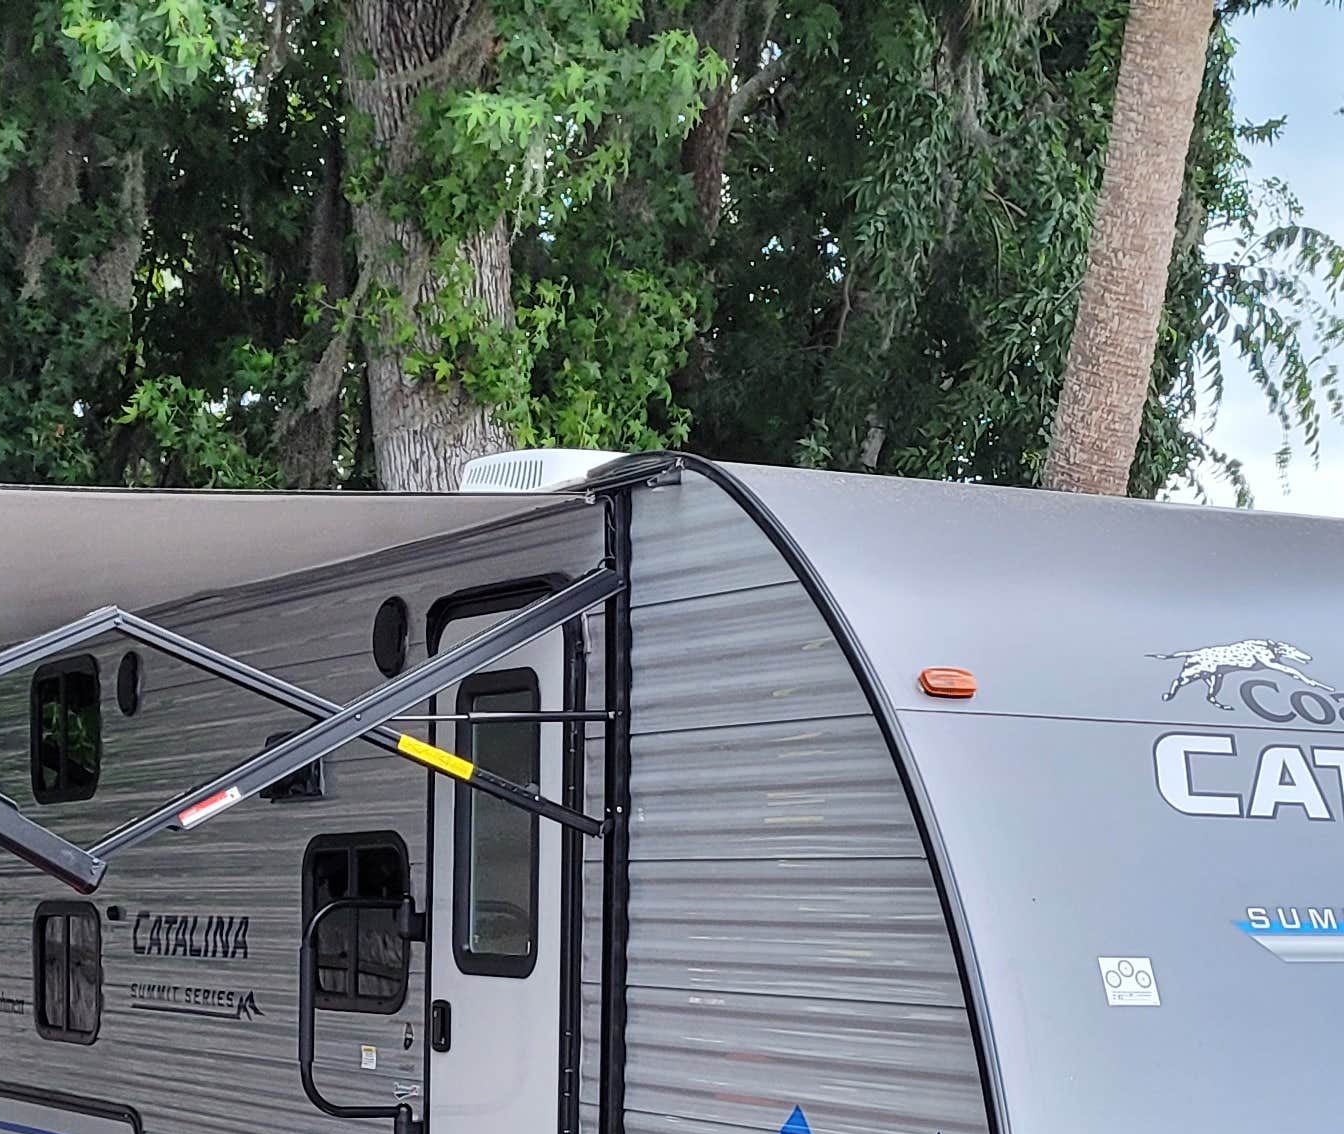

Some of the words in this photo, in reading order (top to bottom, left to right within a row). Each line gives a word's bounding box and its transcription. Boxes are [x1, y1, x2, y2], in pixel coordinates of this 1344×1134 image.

[133, 911, 249, 959] CATALINA
[130, 983, 179, 1001] SUMMIT
[185, 988, 235, 1008] SERIES
